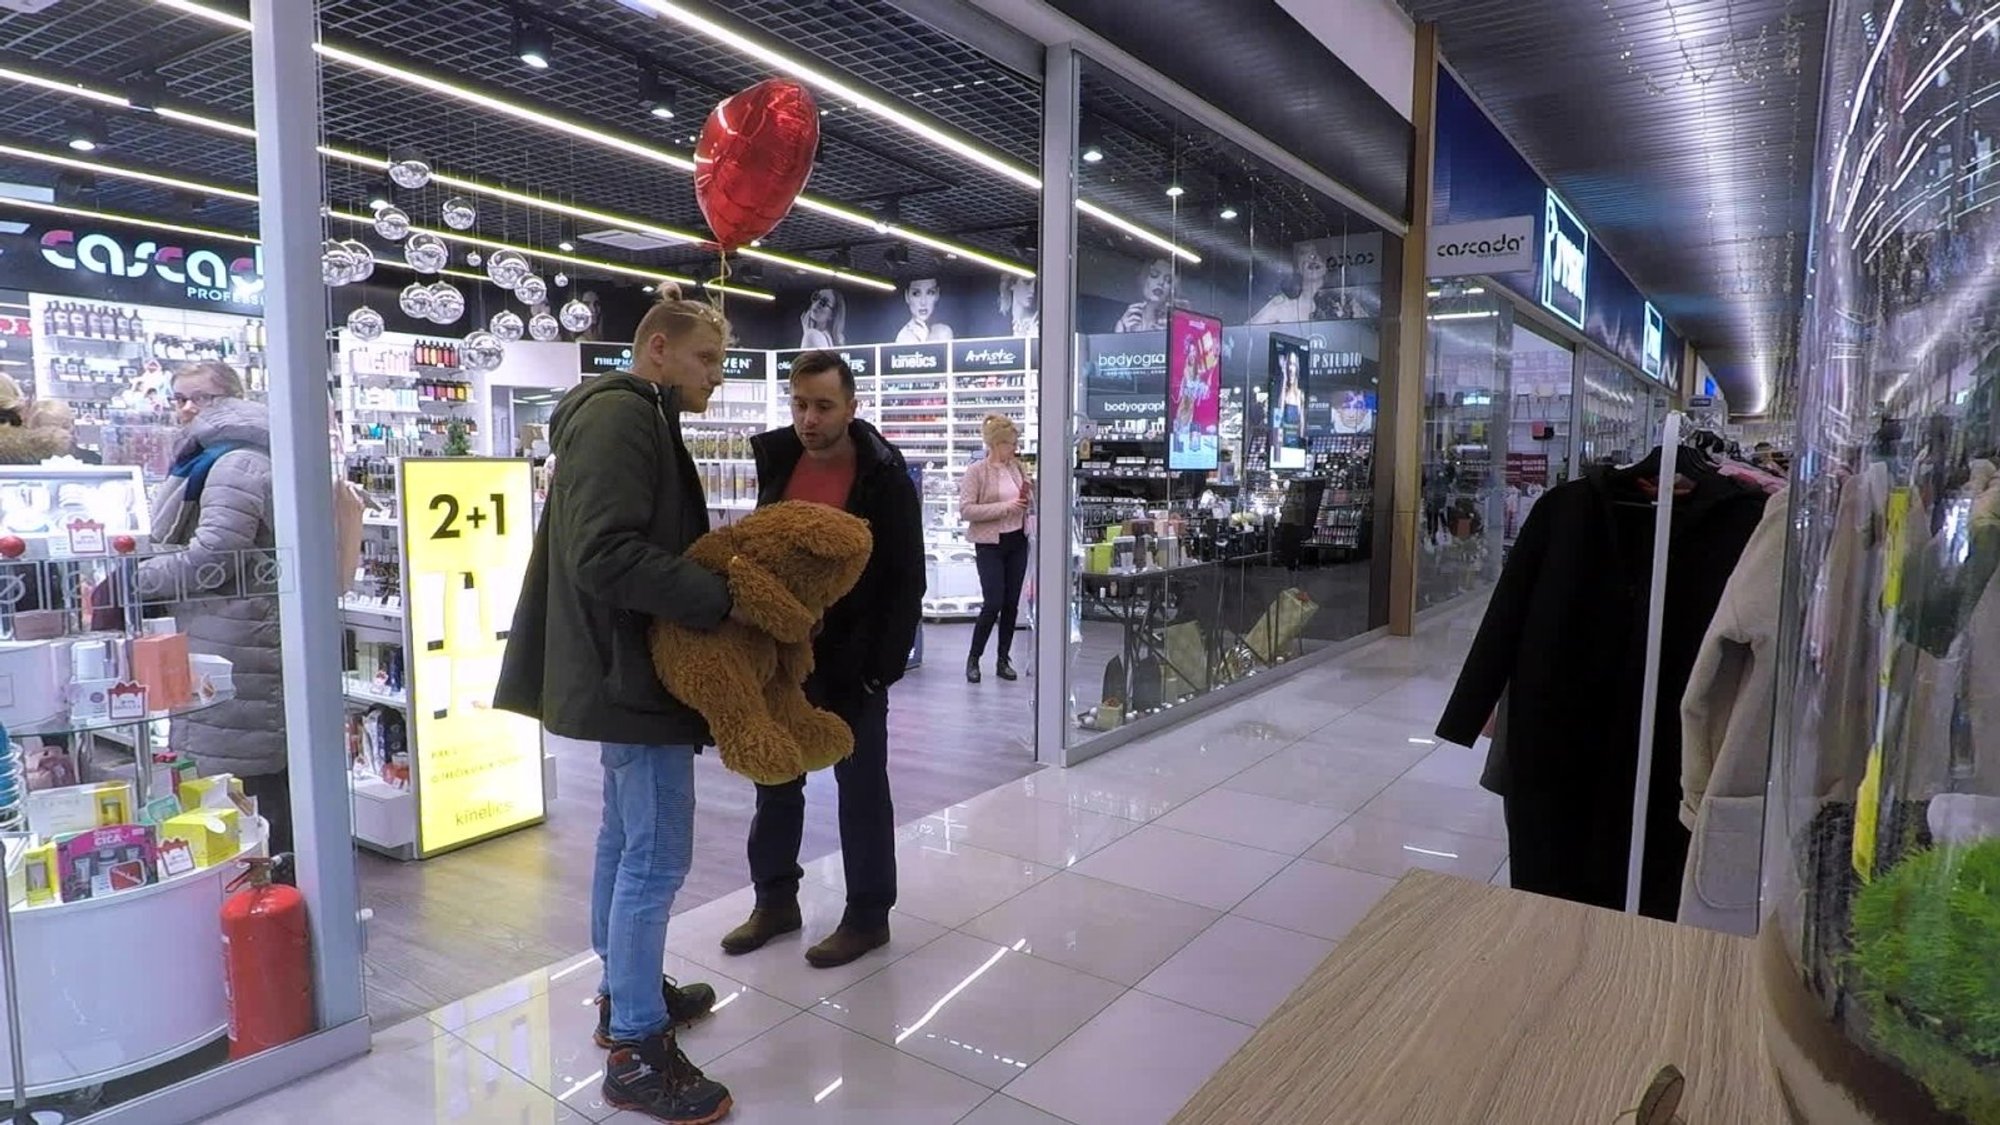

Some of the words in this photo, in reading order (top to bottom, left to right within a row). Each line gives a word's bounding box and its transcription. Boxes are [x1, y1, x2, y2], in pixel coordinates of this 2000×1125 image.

[1437, 233, 1520, 257] cascada
[891, 351, 937, 369] kinetics
[429, 493, 505, 540] 2+1
